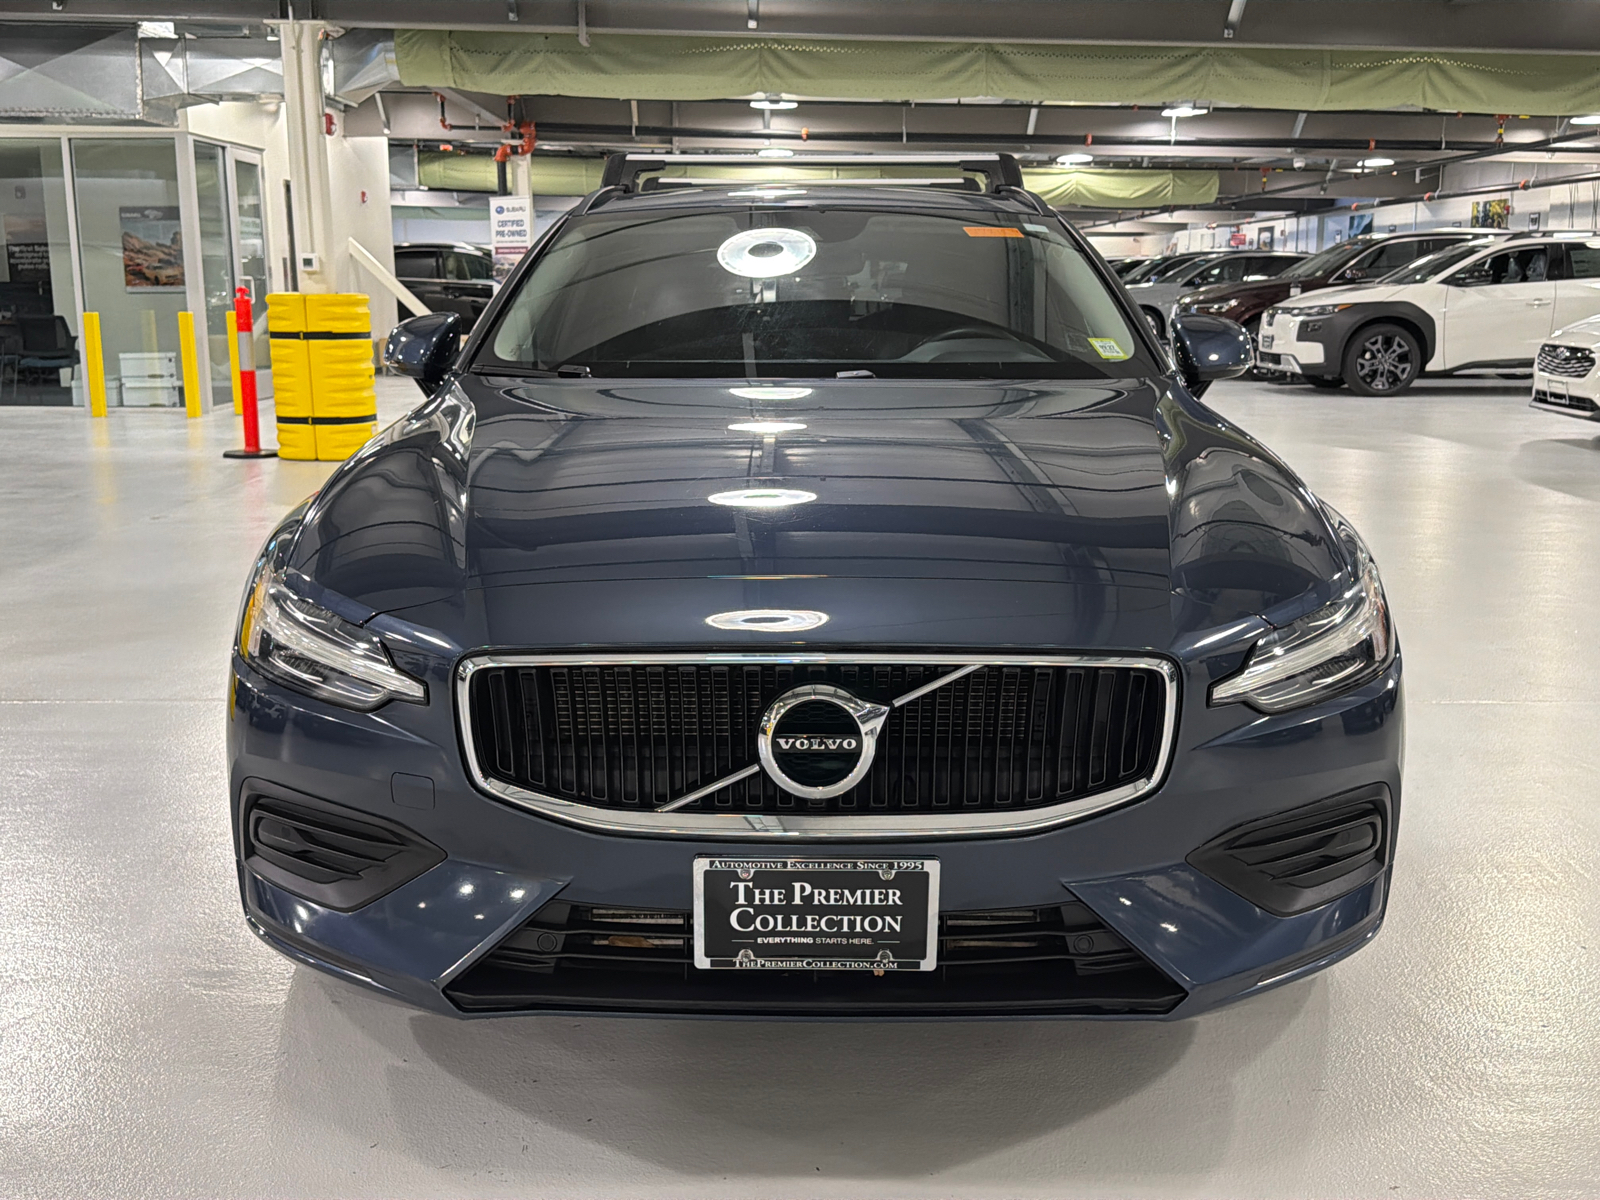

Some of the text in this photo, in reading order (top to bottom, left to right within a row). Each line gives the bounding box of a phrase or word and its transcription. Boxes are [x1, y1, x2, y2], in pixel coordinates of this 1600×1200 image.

[497, 219, 525, 228] CERTIFIED
[496, 229, 527, 238] PRE-OWNED
[776, 738, 857, 750] VOLVO
[893, 861, 923, 870] 1995
[815, 937, 848, 945] STARTS
